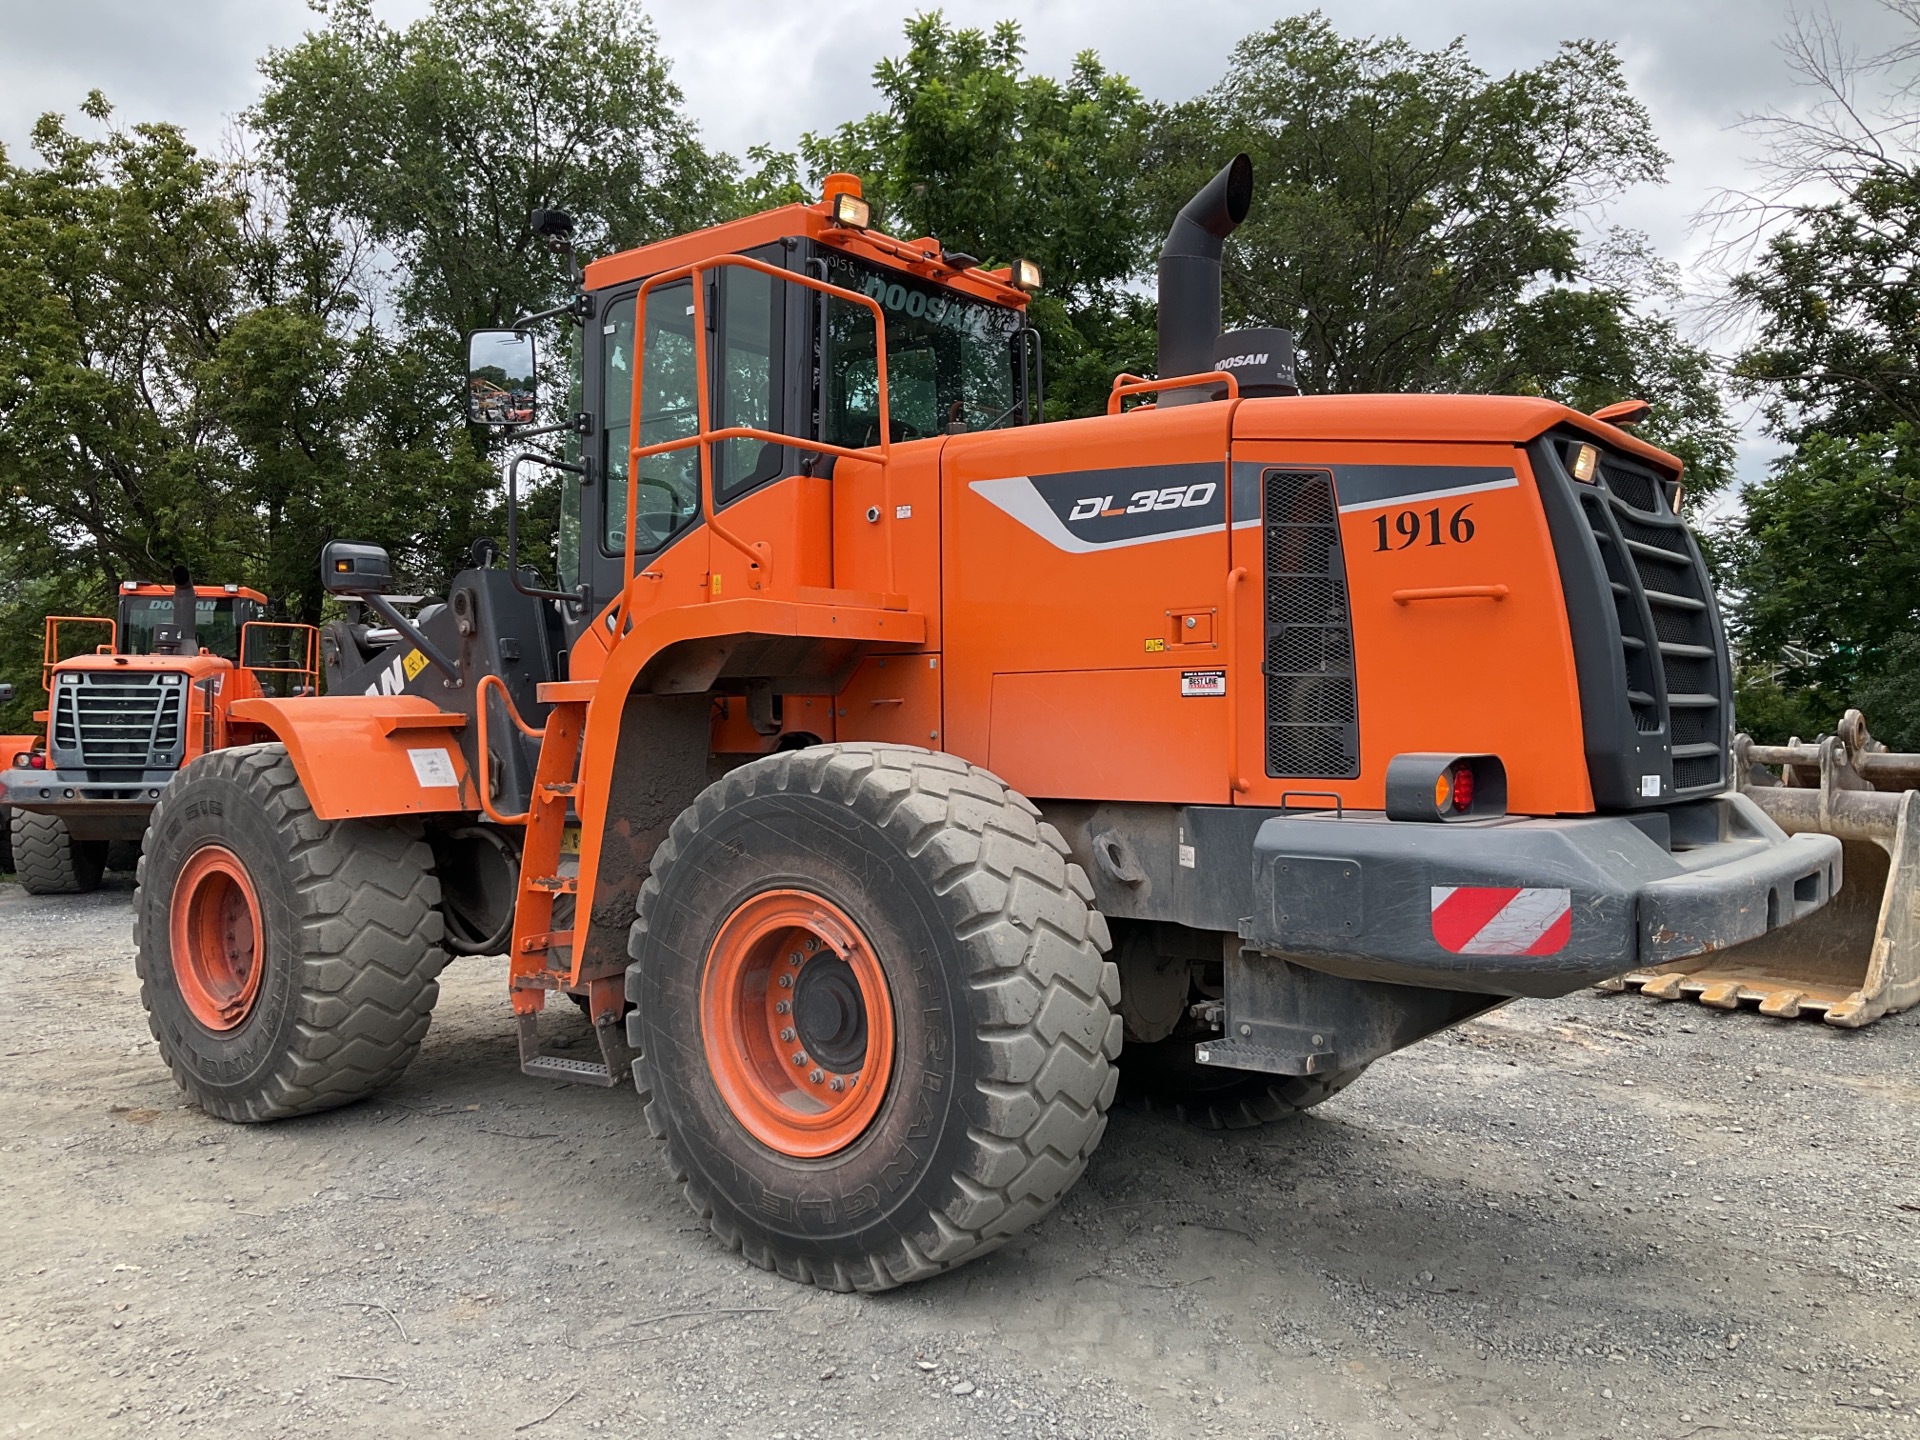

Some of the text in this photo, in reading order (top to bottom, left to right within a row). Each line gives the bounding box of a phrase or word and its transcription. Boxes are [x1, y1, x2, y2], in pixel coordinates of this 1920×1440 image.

[1069, 482, 1217, 521] DL350
[1372, 502, 1475, 552] 1916
[149, 600, 217, 611] DOAN
[759, 947, 945, 1225] TRIANGLE
